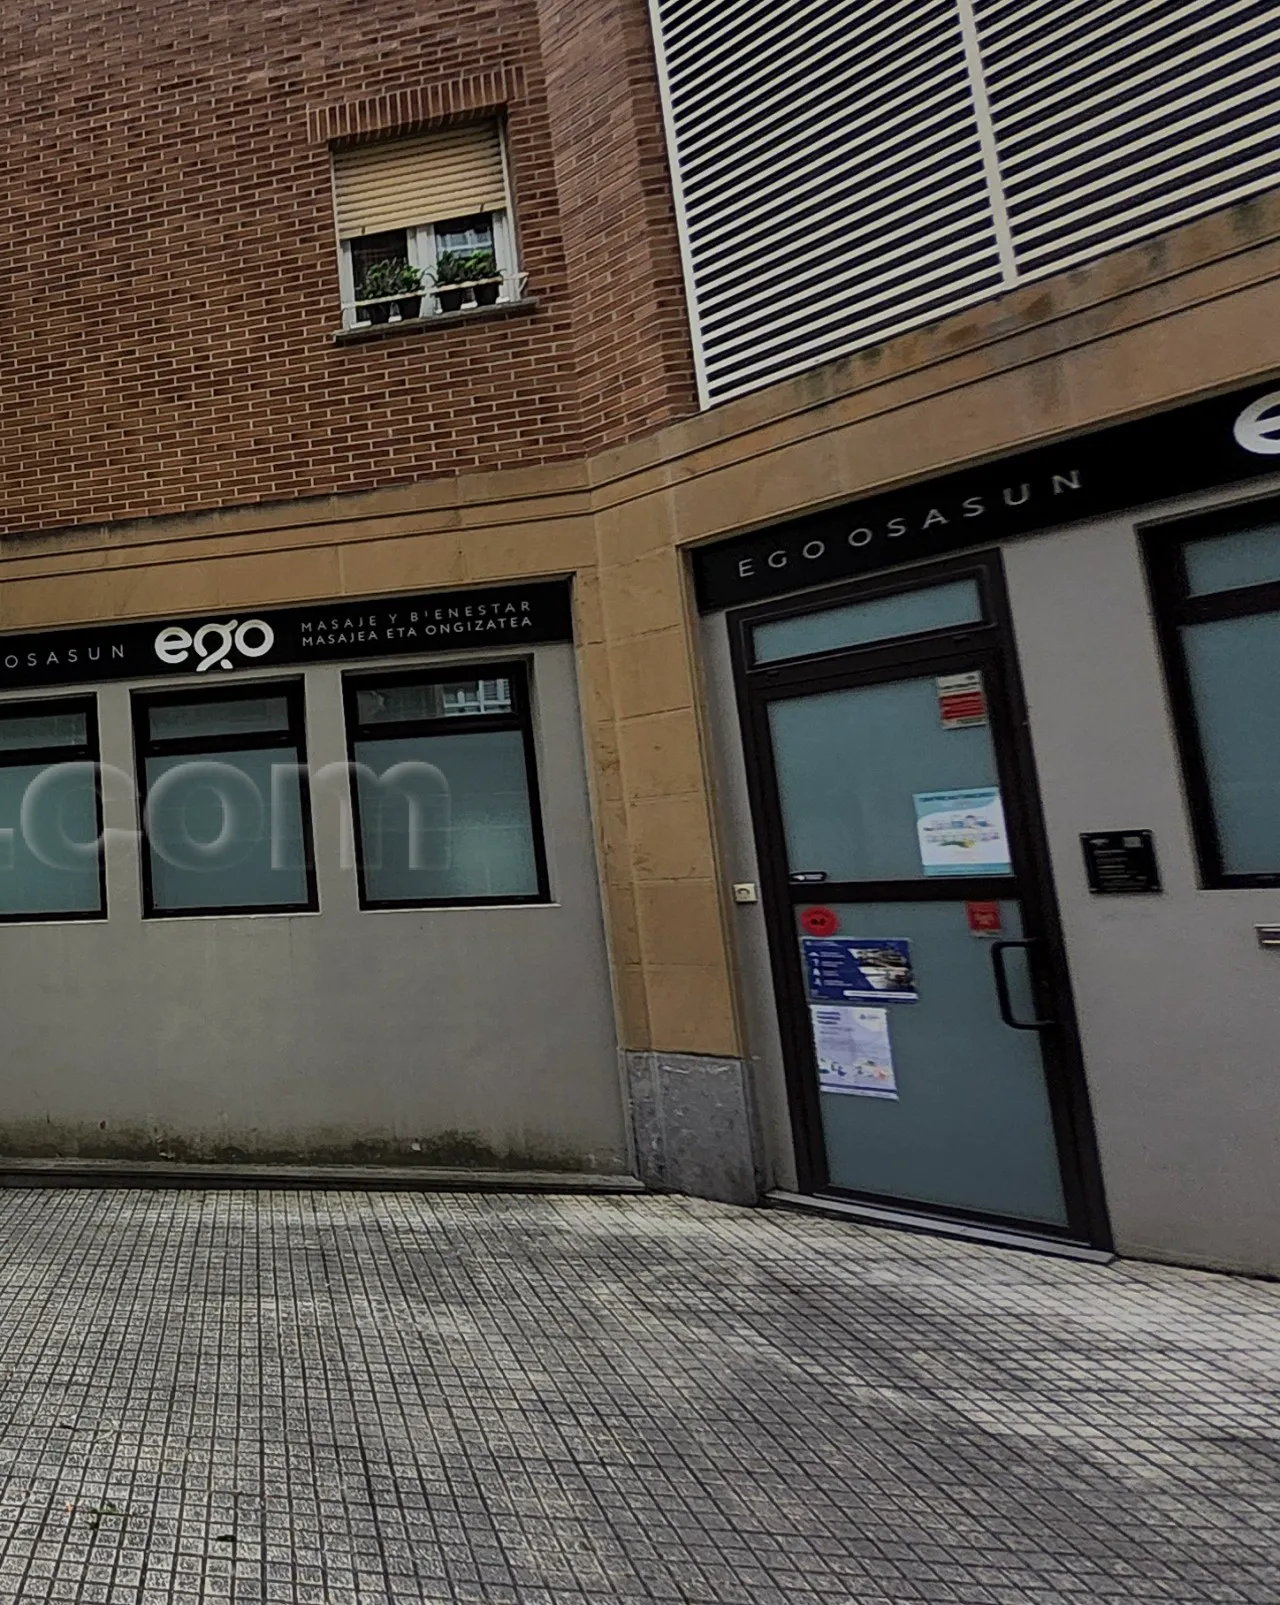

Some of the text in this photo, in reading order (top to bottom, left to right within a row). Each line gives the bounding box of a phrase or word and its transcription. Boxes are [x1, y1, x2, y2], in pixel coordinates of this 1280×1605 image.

[738, 470, 1083, 579] EGO OSASUN
[301, 615, 377, 633] MASAJE
[388, 613, 398, 625] Y
[302, 616, 532, 647] MASAJEA ETA ONGIZATEA
[4, 644, 124, 669] OSASUN
[154, 618, 275, 672] ego
